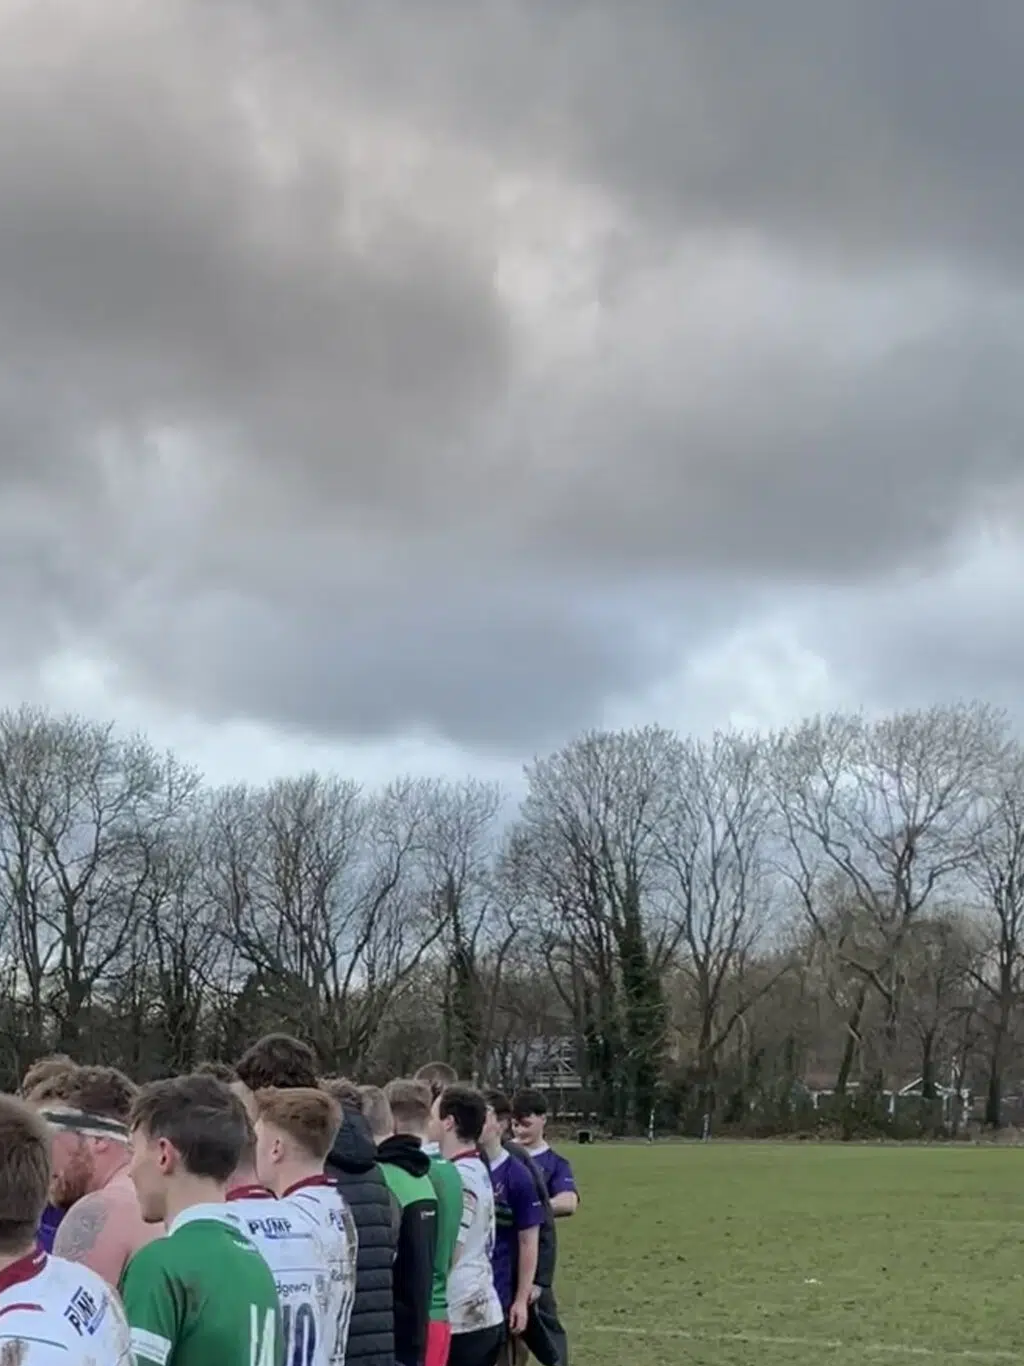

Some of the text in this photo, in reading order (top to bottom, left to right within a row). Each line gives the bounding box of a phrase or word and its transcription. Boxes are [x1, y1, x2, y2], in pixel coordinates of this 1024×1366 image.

[247, 1217, 292, 1235] PUMP
[276, 1280, 312, 1298] dgeway
[64, 1286, 97, 1337] PUMP
